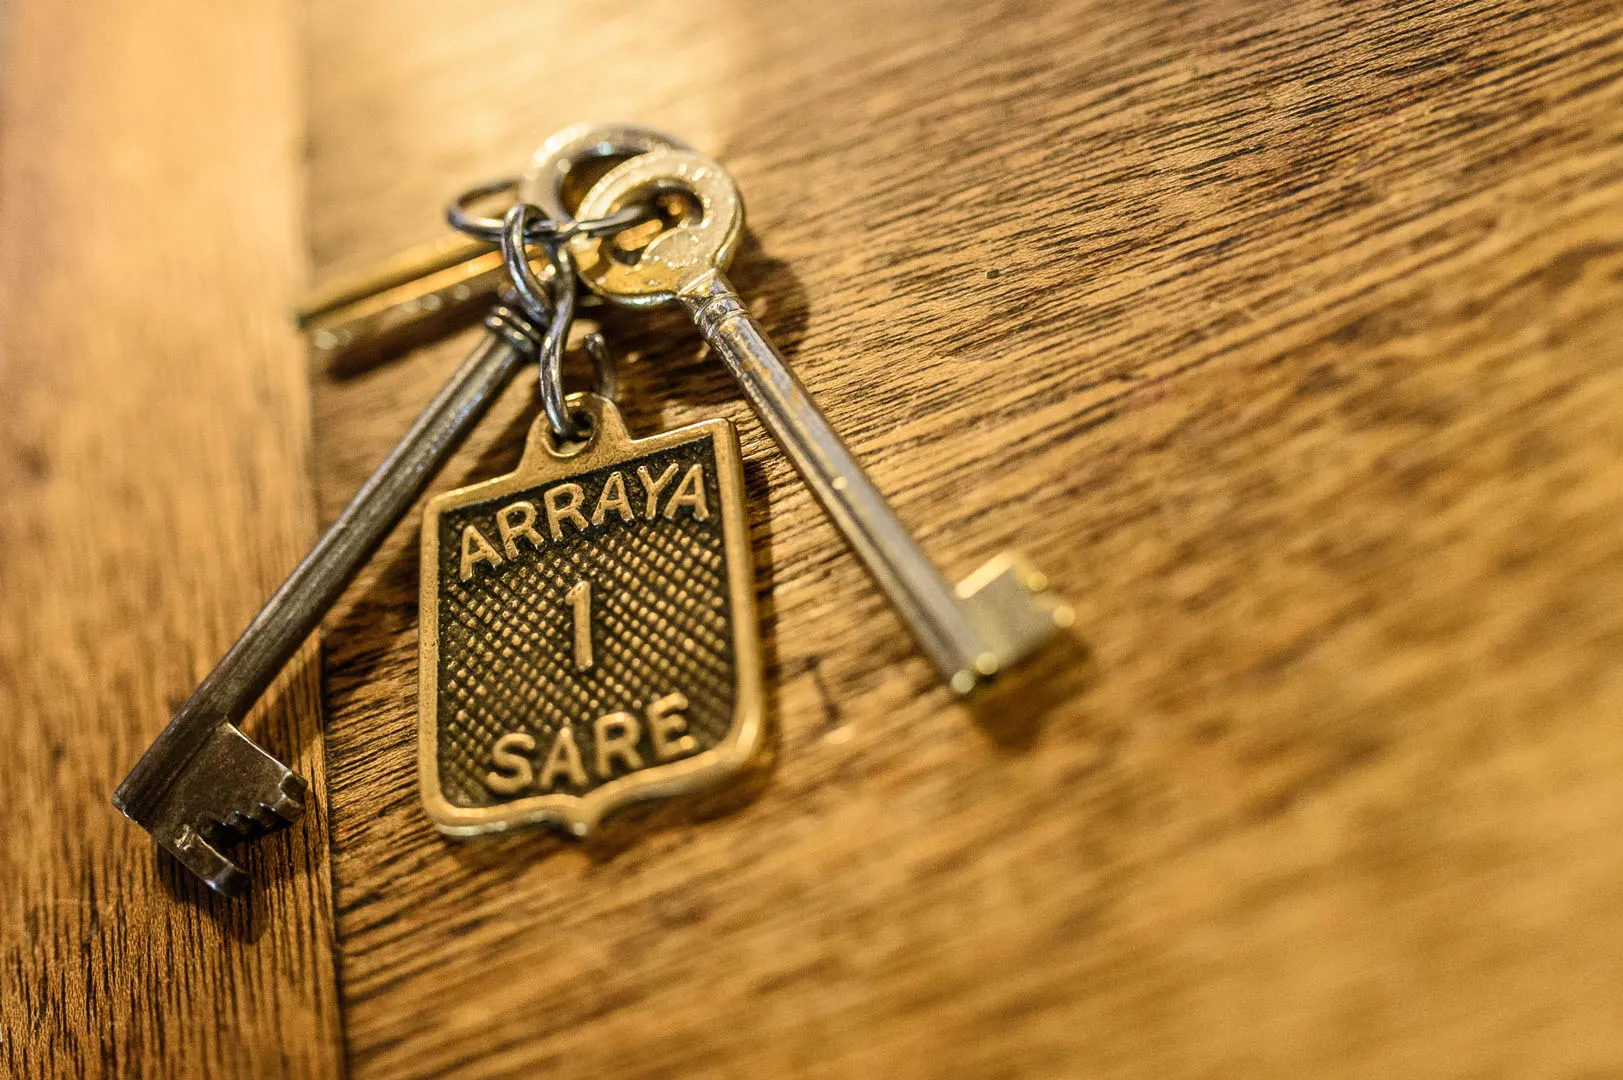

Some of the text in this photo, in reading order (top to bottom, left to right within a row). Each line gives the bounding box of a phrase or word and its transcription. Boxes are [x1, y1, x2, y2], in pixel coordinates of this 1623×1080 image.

[459, 462, 709, 582] ARRAYA
[565, 580, 594, 671] 1
[485, 692, 698, 795] SARE
